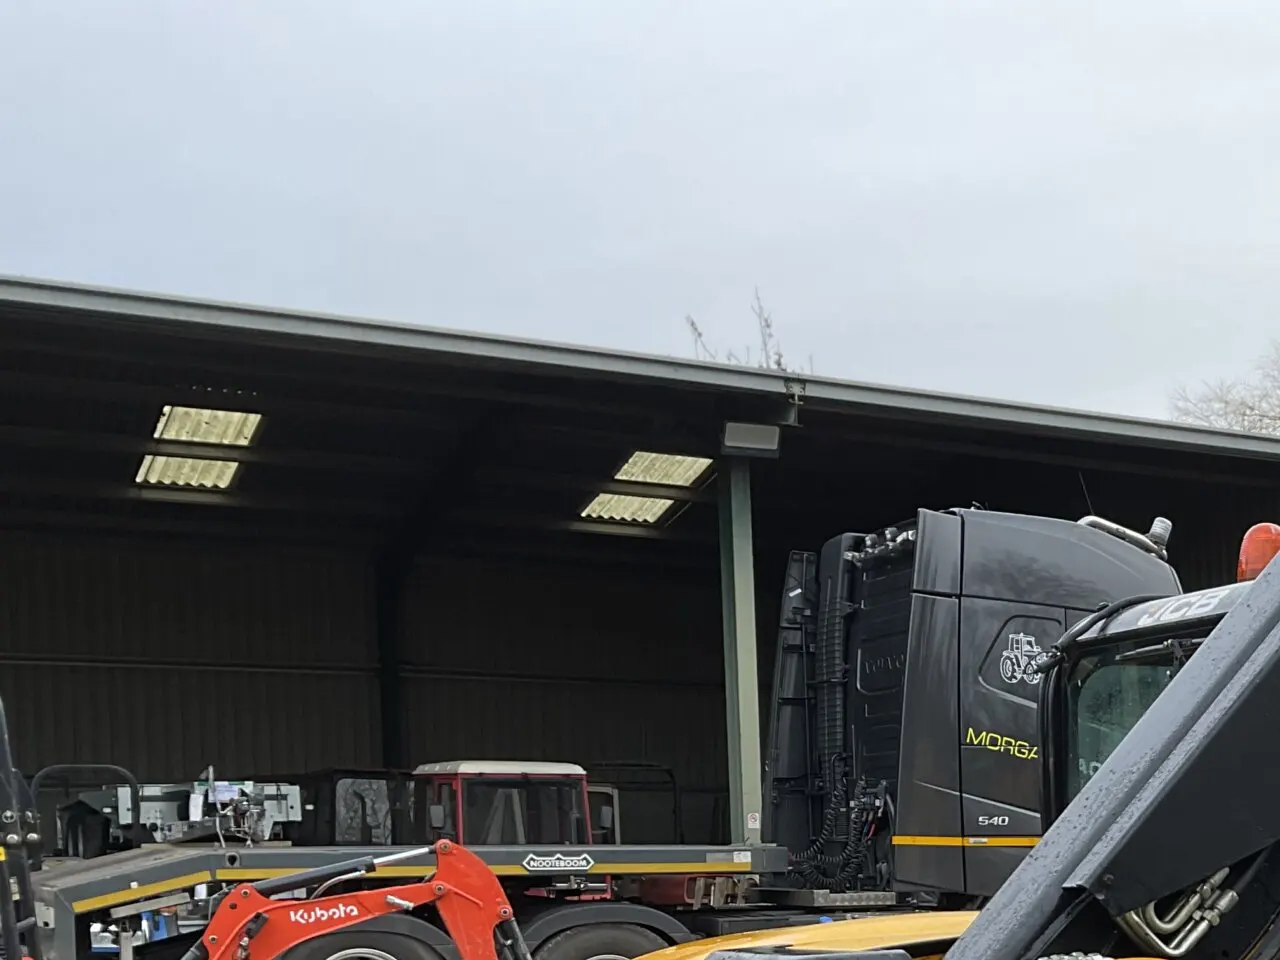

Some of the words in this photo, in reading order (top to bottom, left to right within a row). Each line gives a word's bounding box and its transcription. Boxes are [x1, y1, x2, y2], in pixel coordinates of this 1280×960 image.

[1137, 589, 1230, 625] JCB
[978, 816, 1009, 826] 540
[529, 859, 587, 868] NOOTEBOOM
[289, 903, 359, 924] Kubota
